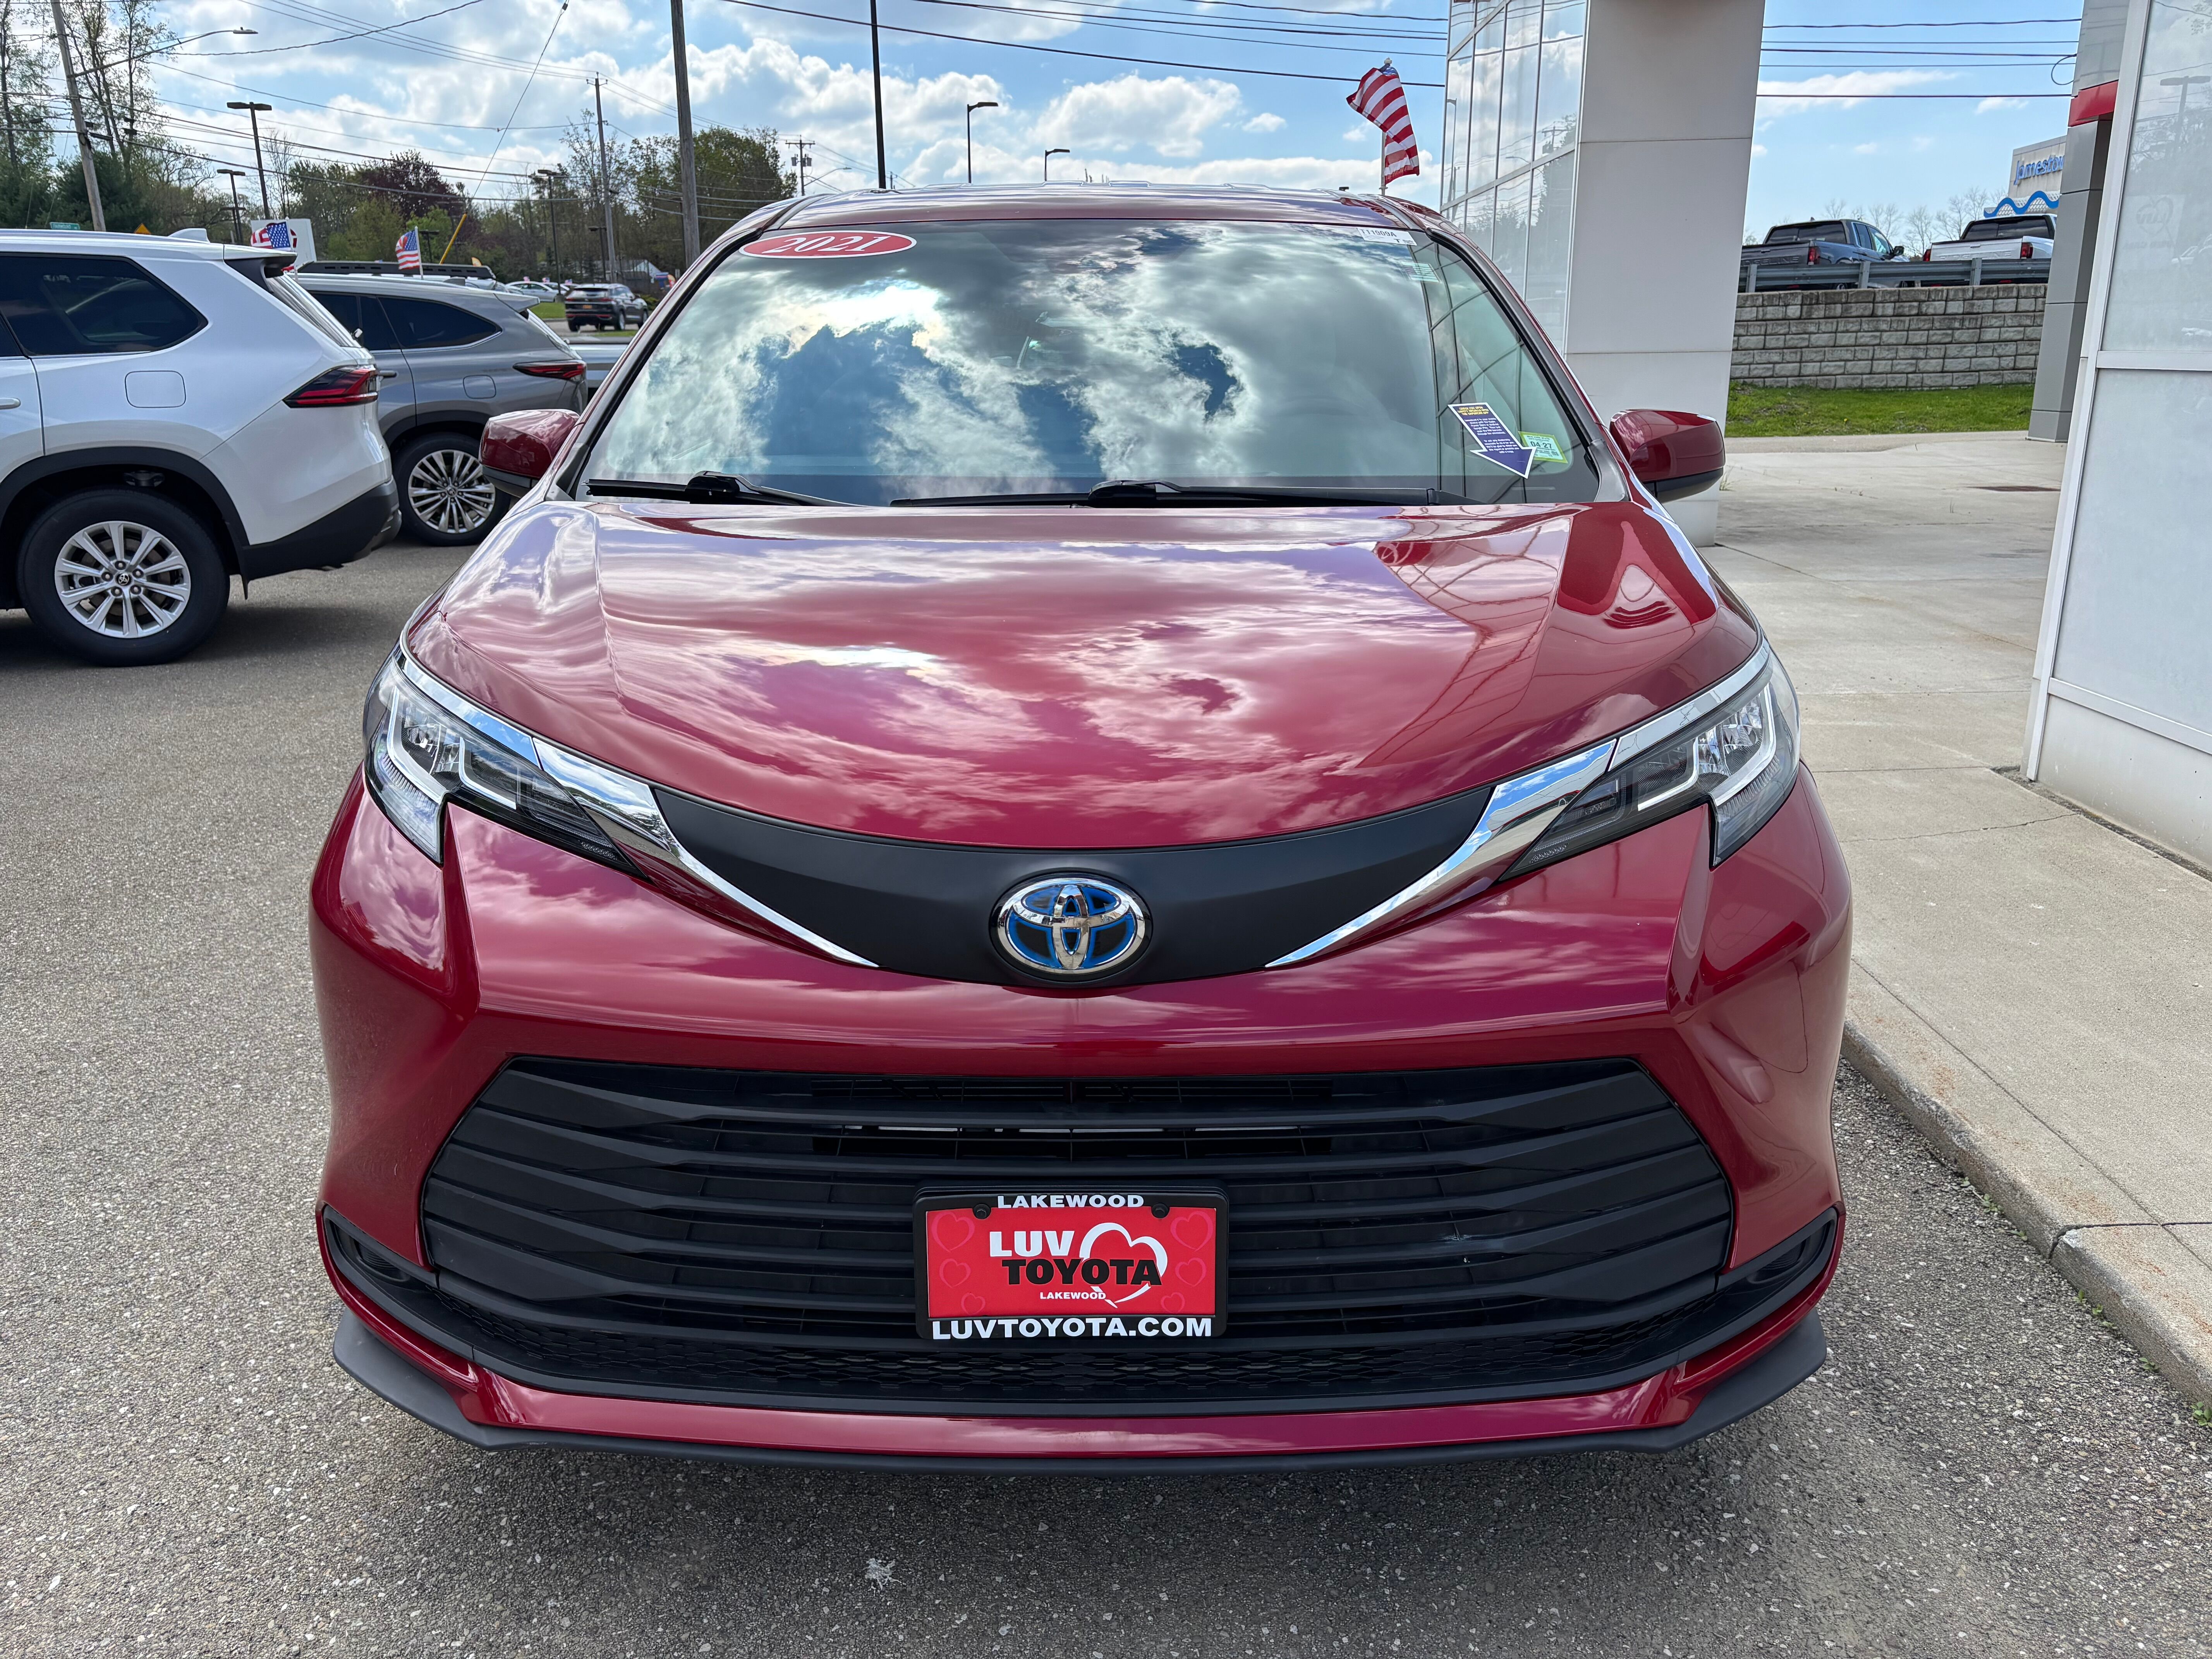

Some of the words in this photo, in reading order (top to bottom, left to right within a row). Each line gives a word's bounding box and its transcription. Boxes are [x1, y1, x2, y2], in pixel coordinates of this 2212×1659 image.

[761, 235, 891, 254] 2021
[998, 1194, 1144, 1208] LAKEWOOD
[989, 1231, 1075, 1257] LUV
[1001, 1259, 1161, 1285] TOYOTA
[1039, 1291, 1107, 1300] LAKEWOOD
[932, 1317, 1212, 1340] LUVTOYOTA.COM
